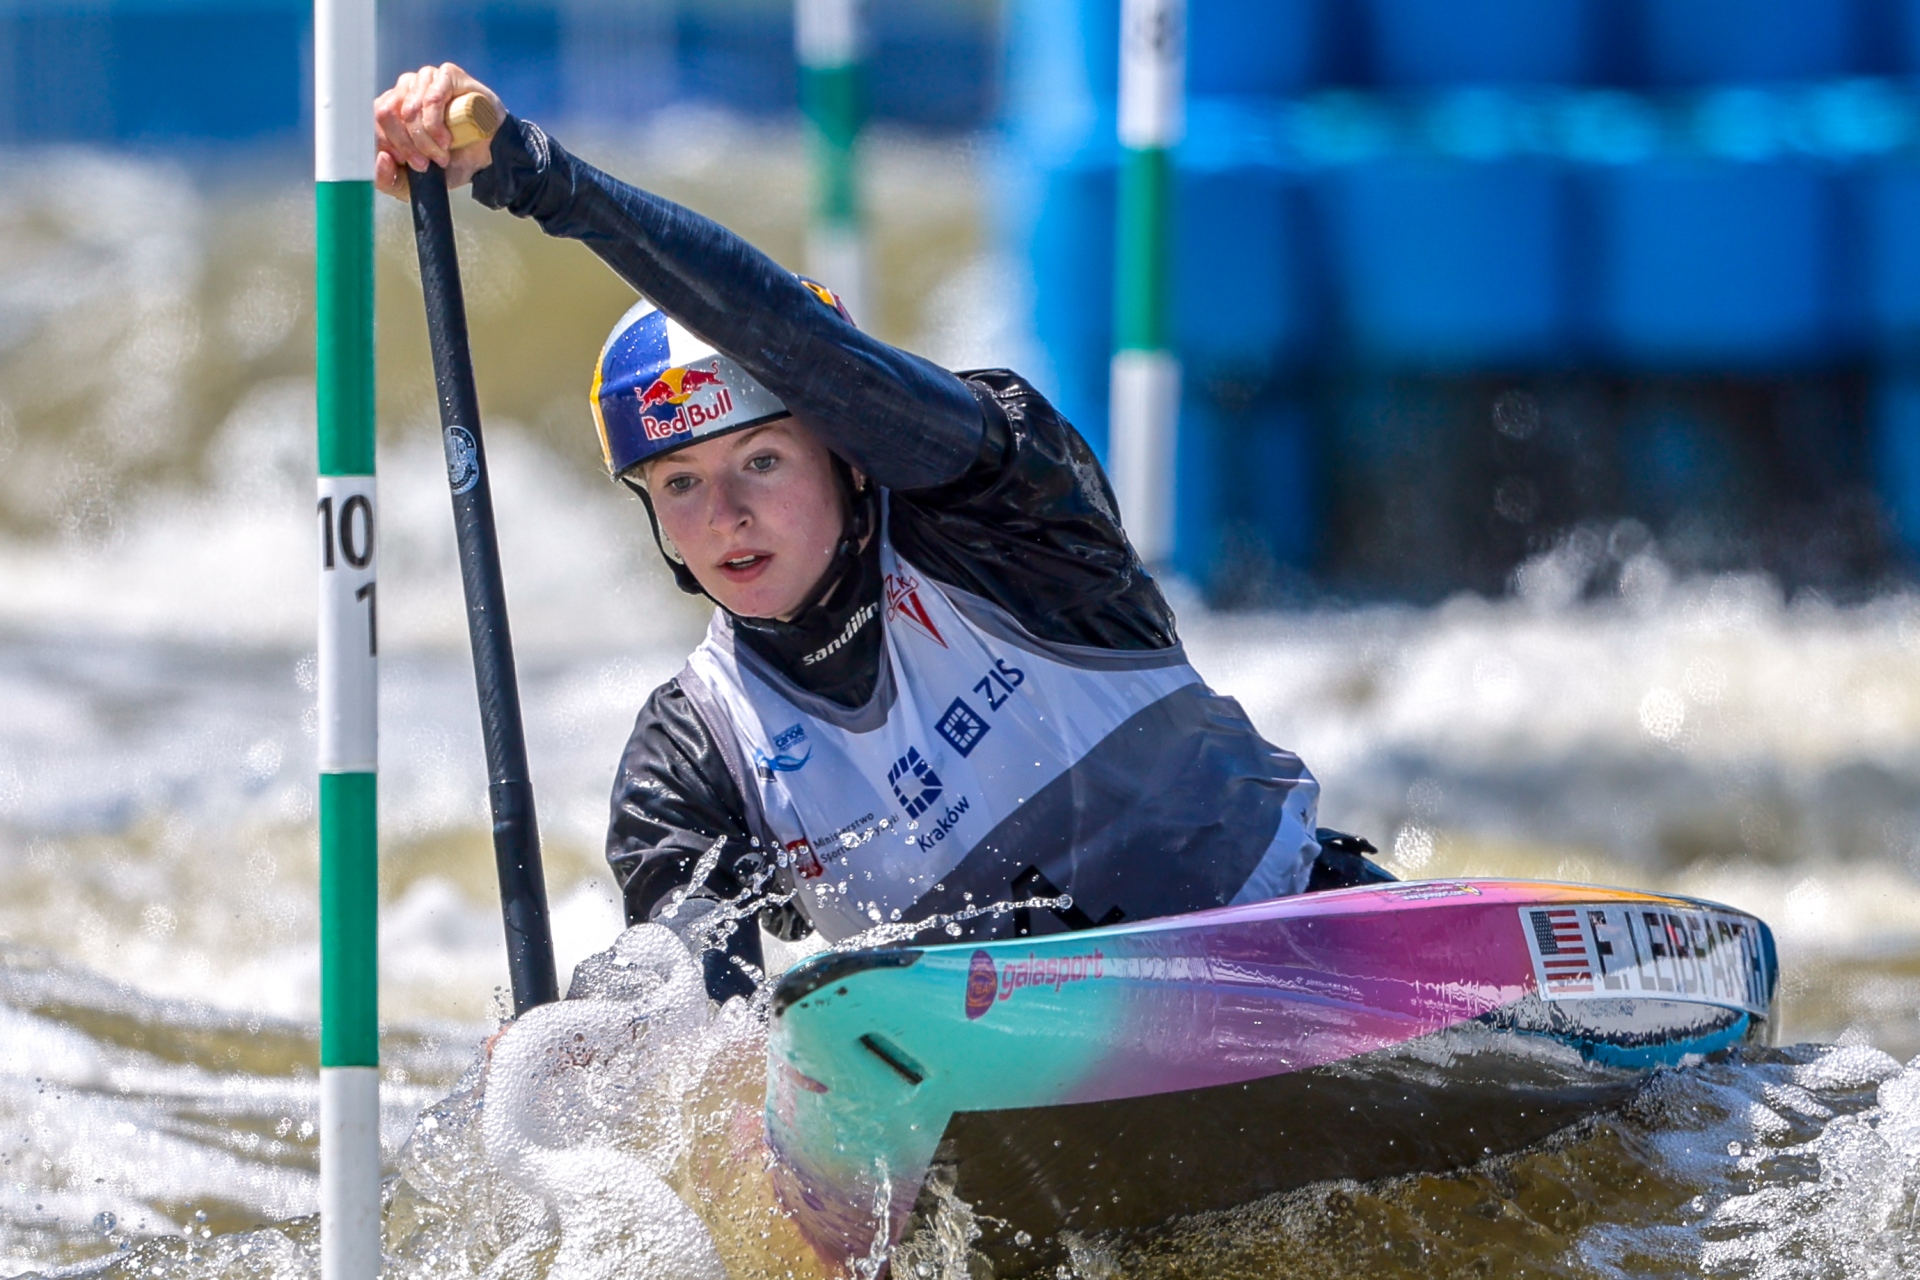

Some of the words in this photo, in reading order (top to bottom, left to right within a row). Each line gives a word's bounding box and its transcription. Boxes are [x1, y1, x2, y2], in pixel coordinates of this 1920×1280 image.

[641, 407, 690, 440] Red
[687, 388, 733, 427] Bull
[317, 494, 374, 571] 10
[355, 581, 377, 658] 1
[972, 658, 1025, 712] ZIS
[917, 797, 970, 853] Kraków
[998, 948, 1104, 1001] galasport
